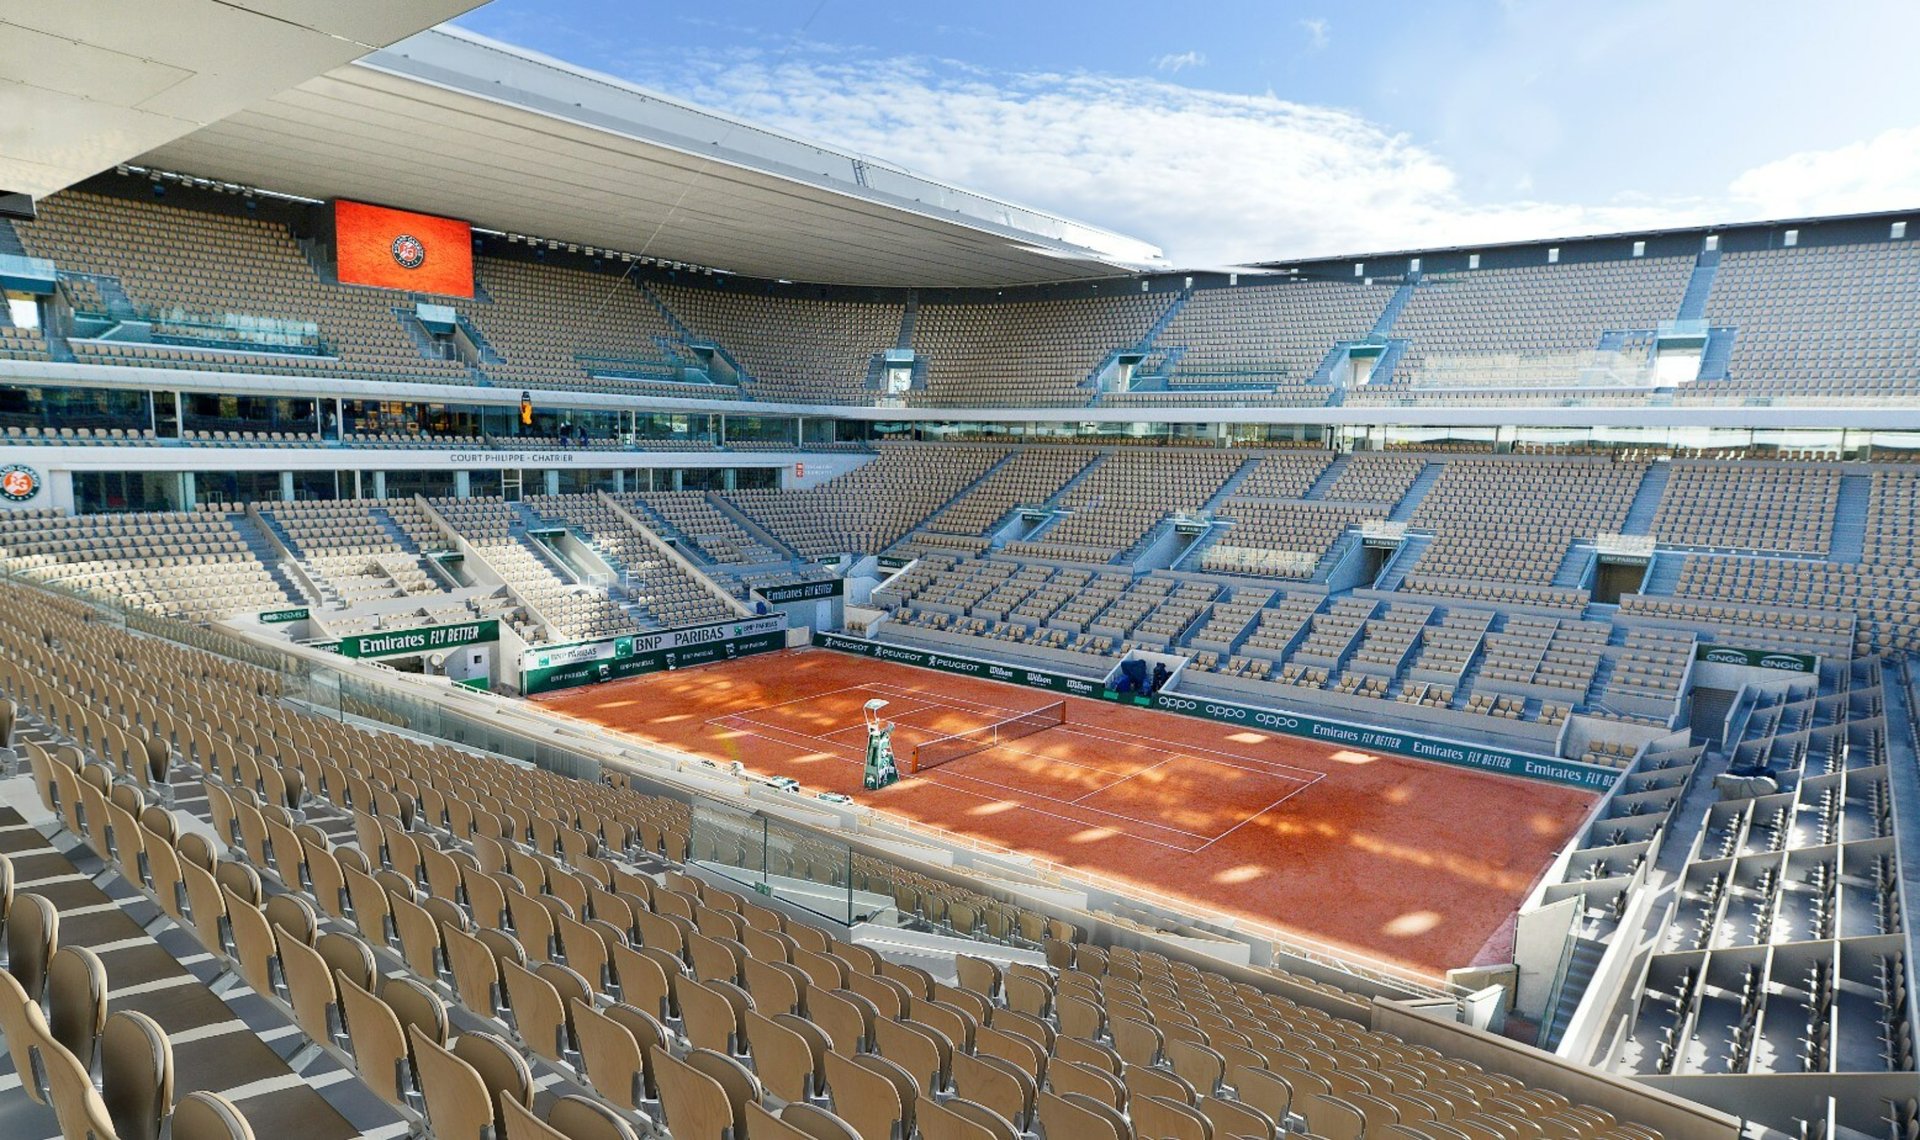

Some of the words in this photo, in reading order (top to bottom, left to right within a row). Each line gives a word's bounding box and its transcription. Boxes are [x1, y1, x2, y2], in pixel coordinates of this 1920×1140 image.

[450, 454, 482, 462] COURT
[485, 454, 525, 462] PHILIPPE
[532, 454, 573, 462] CHATRIER
[766, 588, 803, 601] Emirates
[359, 634, 425, 654] Emirates
[430, 629, 447, 645] FLY
[447, 625, 479, 643] BETTER
[636, 636, 662, 652] BNP
[674, 627, 724, 645] PARIBAS
[832, 639, 869, 652] PEUGEOT
[882, 648, 923, 662] PEUGEOT
[936, 659, 980, 672] PEUGEOT
[989, 665, 1013, 677] Wilson
[1027, 672, 1052, 685] Wilson
[1066, 679, 1093, 692] Wilson
[1159, 695, 1197, 710] oppo
[1205, 704, 1246, 719] oppo
[1255, 712, 1299, 728] oppo
[1313, 724, 1359, 741] Emirates
[1360, 732, 1375, 744] FLY
[1374, 734, 1402, 749] BETTER
[1413, 741, 1464, 760] Emirates
[1467, 751, 1481, 764] FLY
[1481, 753, 1512, 769] BETTER
[1524, 761, 1582, 781] Emirates
[1585, 771, 1602, 785] FLY
